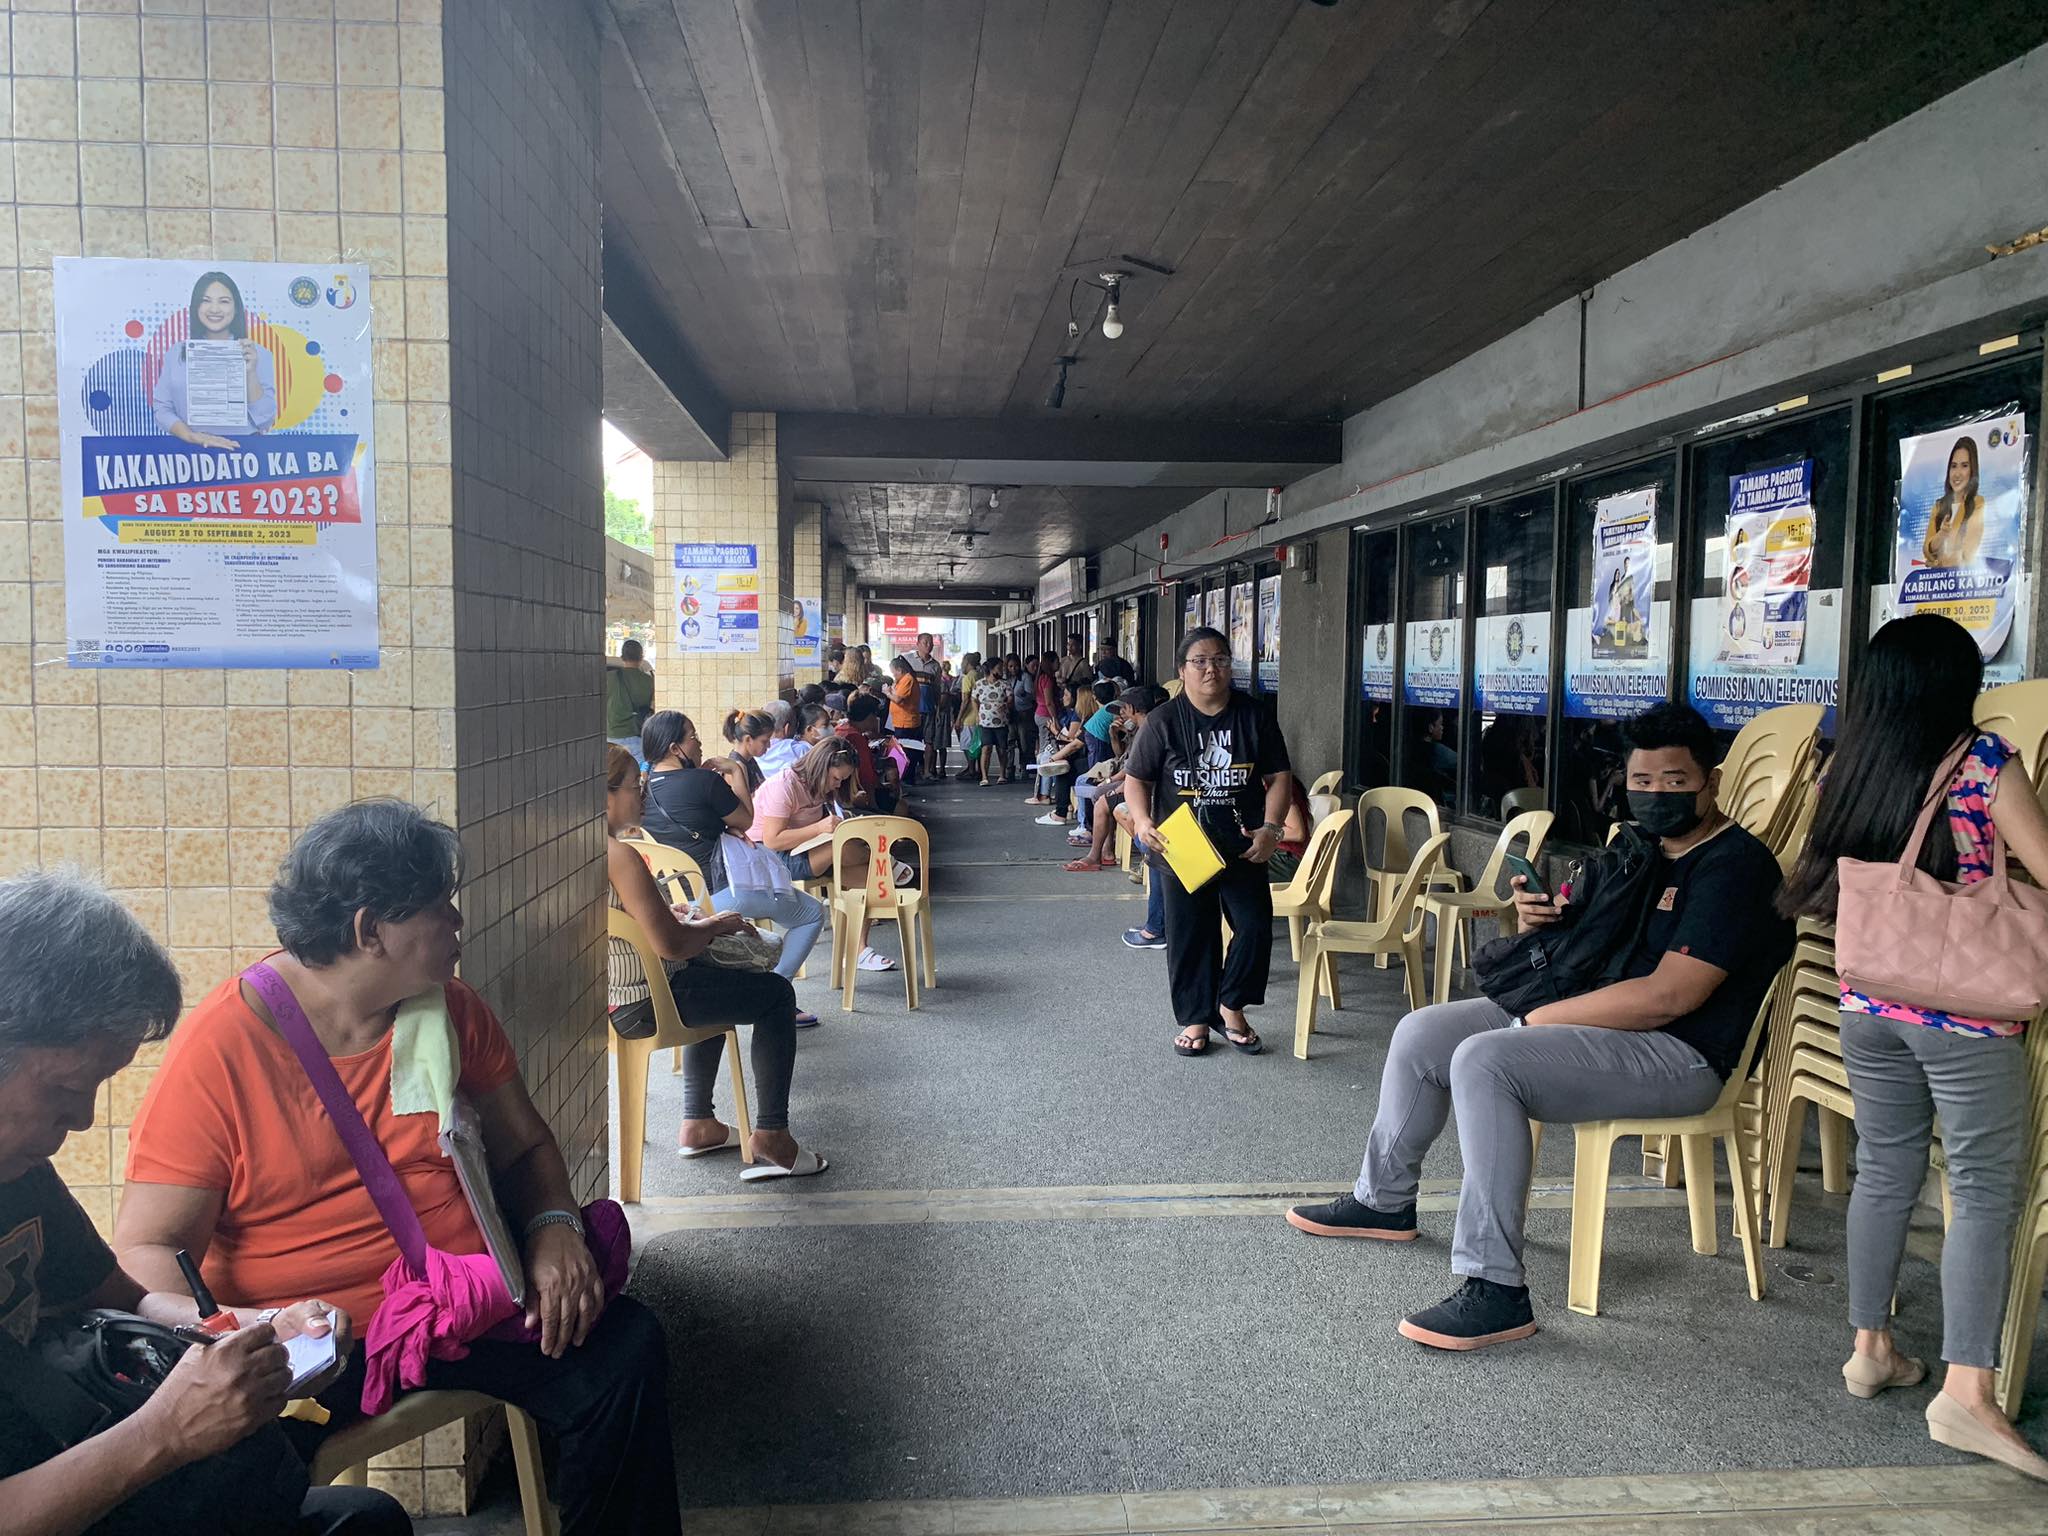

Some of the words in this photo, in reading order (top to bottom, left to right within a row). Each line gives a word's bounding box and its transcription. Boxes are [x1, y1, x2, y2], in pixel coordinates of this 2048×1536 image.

[95, 453, 259, 491] KAKANDIDATO
[268, 453, 300, 476] KA
[307, 451, 339, 473] BA
[1740, 475, 1769, 493] TAMANG
[1770, 467, 1804, 487] PAGBOTO
[135, 493, 168, 514] SA
[177, 490, 242, 514] BSKE
[252, 484, 339, 515] 2023?
[1737, 494, 1746, 508] SA
[1747, 488, 1776, 507] TAMANG
[1777, 482, 1803, 501] BALOTA
[144, 529, 176, 537] AUGUST
[207, 530, 254, 538] SEPTEMBER
[256, 530, 266, 539] 2,
[269, 530, 291, 538] 2023
[684, 547, 714, 555] TAMANG
[716, 547, 748, 555] PAGBOTO
[693, 555, 722, 564] TAMANG
[1904, 579, 1956, 594] KABILANG
[1958, 578, 1974, 589] KA
[1978, 576, 2004, 588] DITO
[1920, 572, 1948, 580] BARANGAY
[1478, 674, 1510, 691] COMMISSION
[1521, 674, 1548, 692] ELECTION
[1570, 674, 1614, 694] COMMISSION
[1615, 674, 1626, 695] ON
[1627, 674, 1666, 696] ELECTION
[1695, 676, 1756, 700] COMMISSION
[1757, 676, 1774, 702] ON
[1776, 678, 1839, 706] ELECTIONS
[1713, 704, 1733, 714] Office
[1734, 706, 1742, 714] of
[1198, 732, 1204, 750] I
[1208, 730, 1232, 746] AM
[1174, 769, 1248, 787] STONGER
[1202, 786, 1228, 797] Than
[876, 834, 888, 898] BMS
[1472, 910, 1498, 918] BMS
